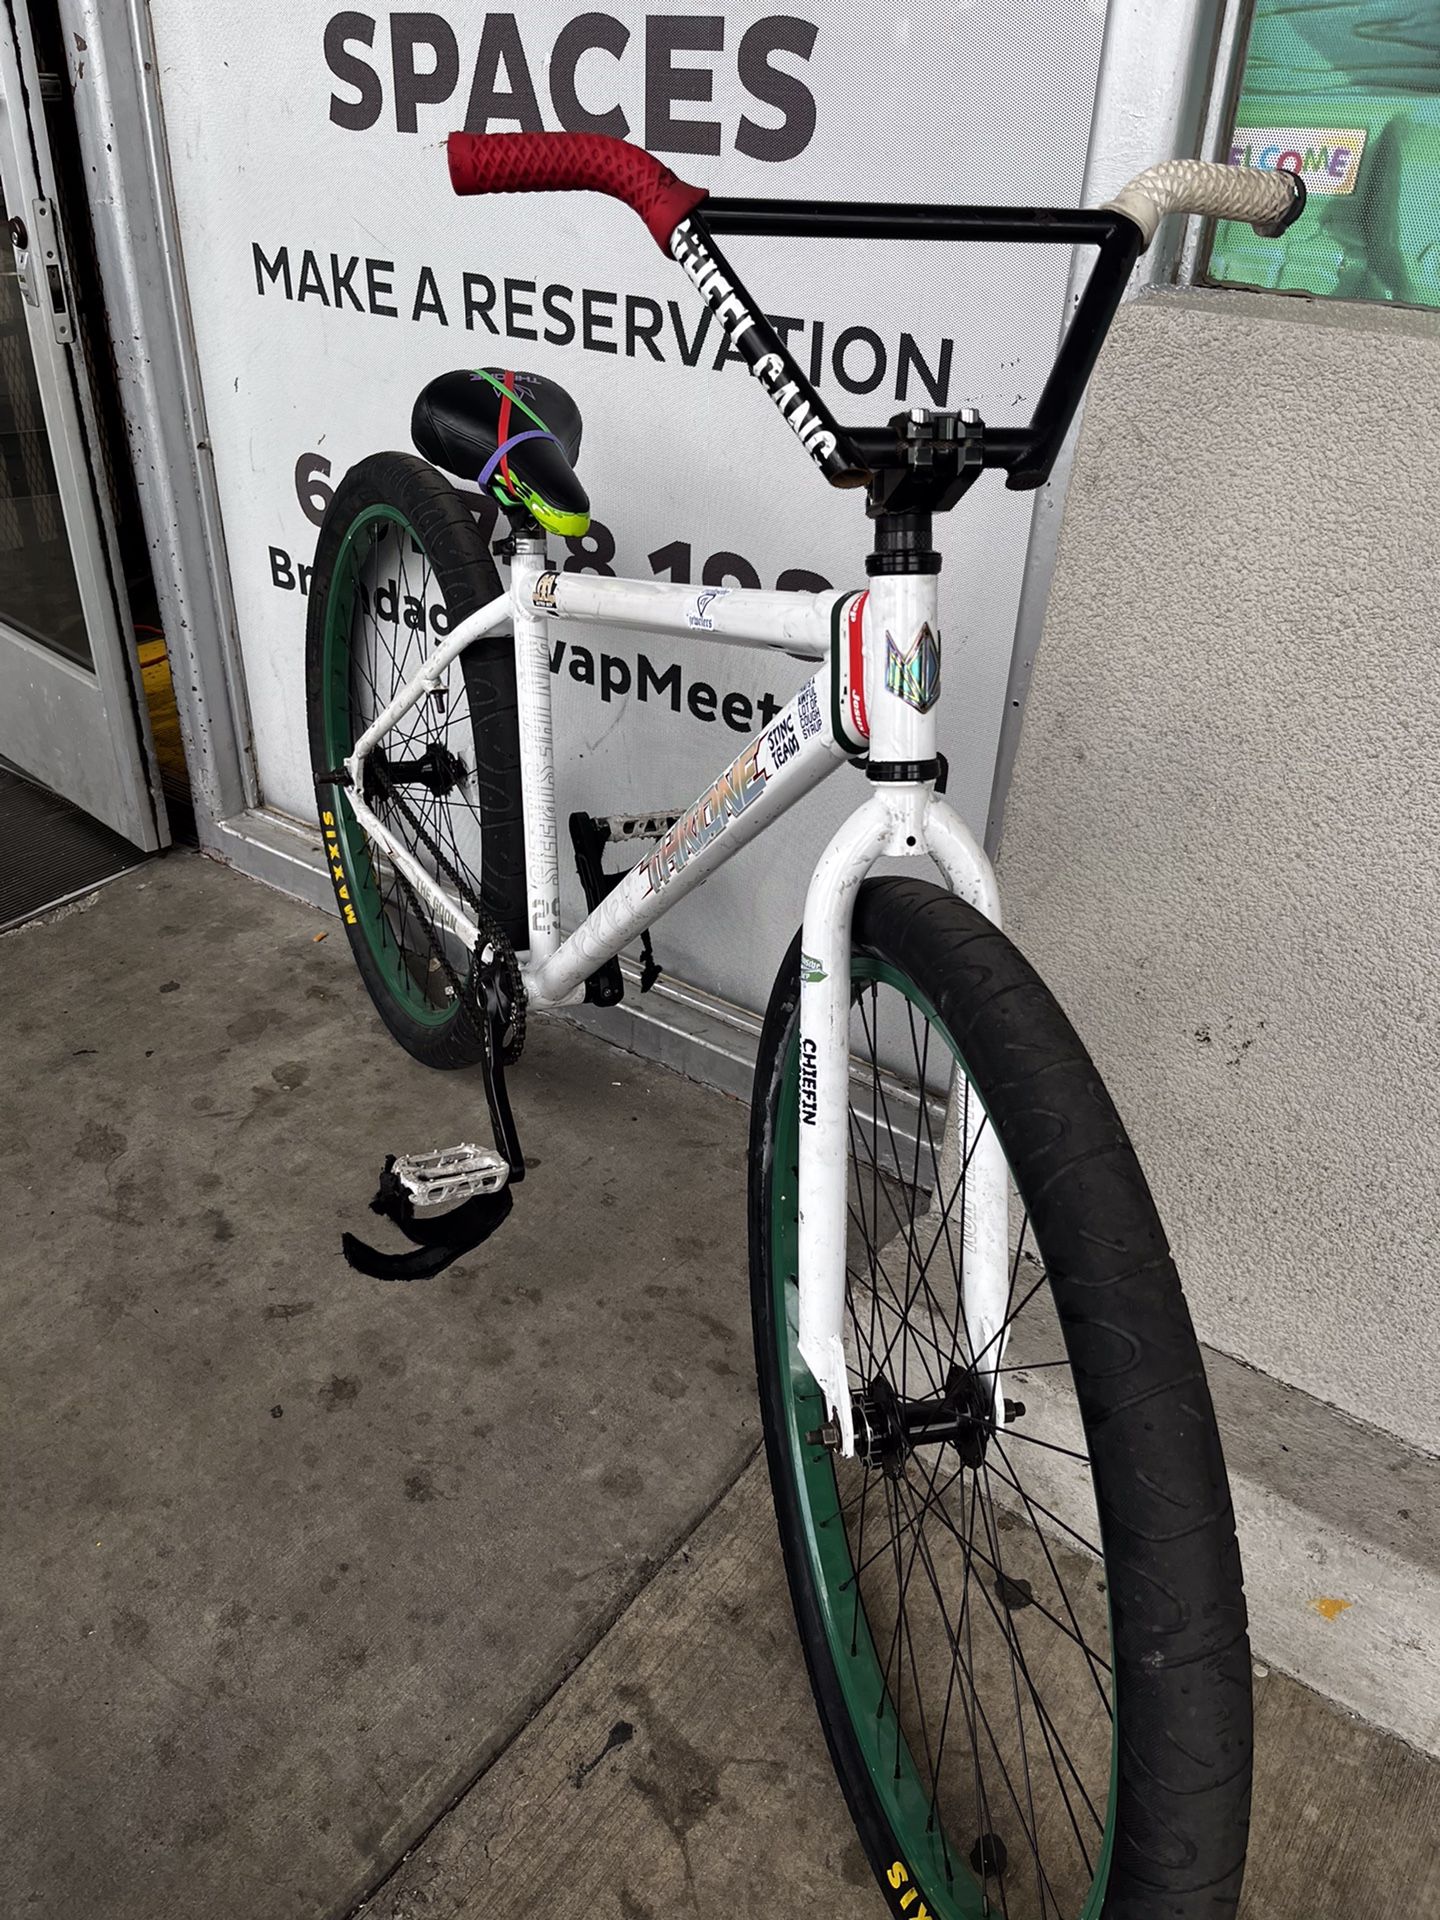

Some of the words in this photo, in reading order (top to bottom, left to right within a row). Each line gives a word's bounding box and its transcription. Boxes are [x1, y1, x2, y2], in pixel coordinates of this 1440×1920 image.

[323, 11, 820, 162] SPACES
[251, 242, 398, 318] MAKE
[412, 270, 449, 324] A
[322, 811, 357, 924] MAXXIS
